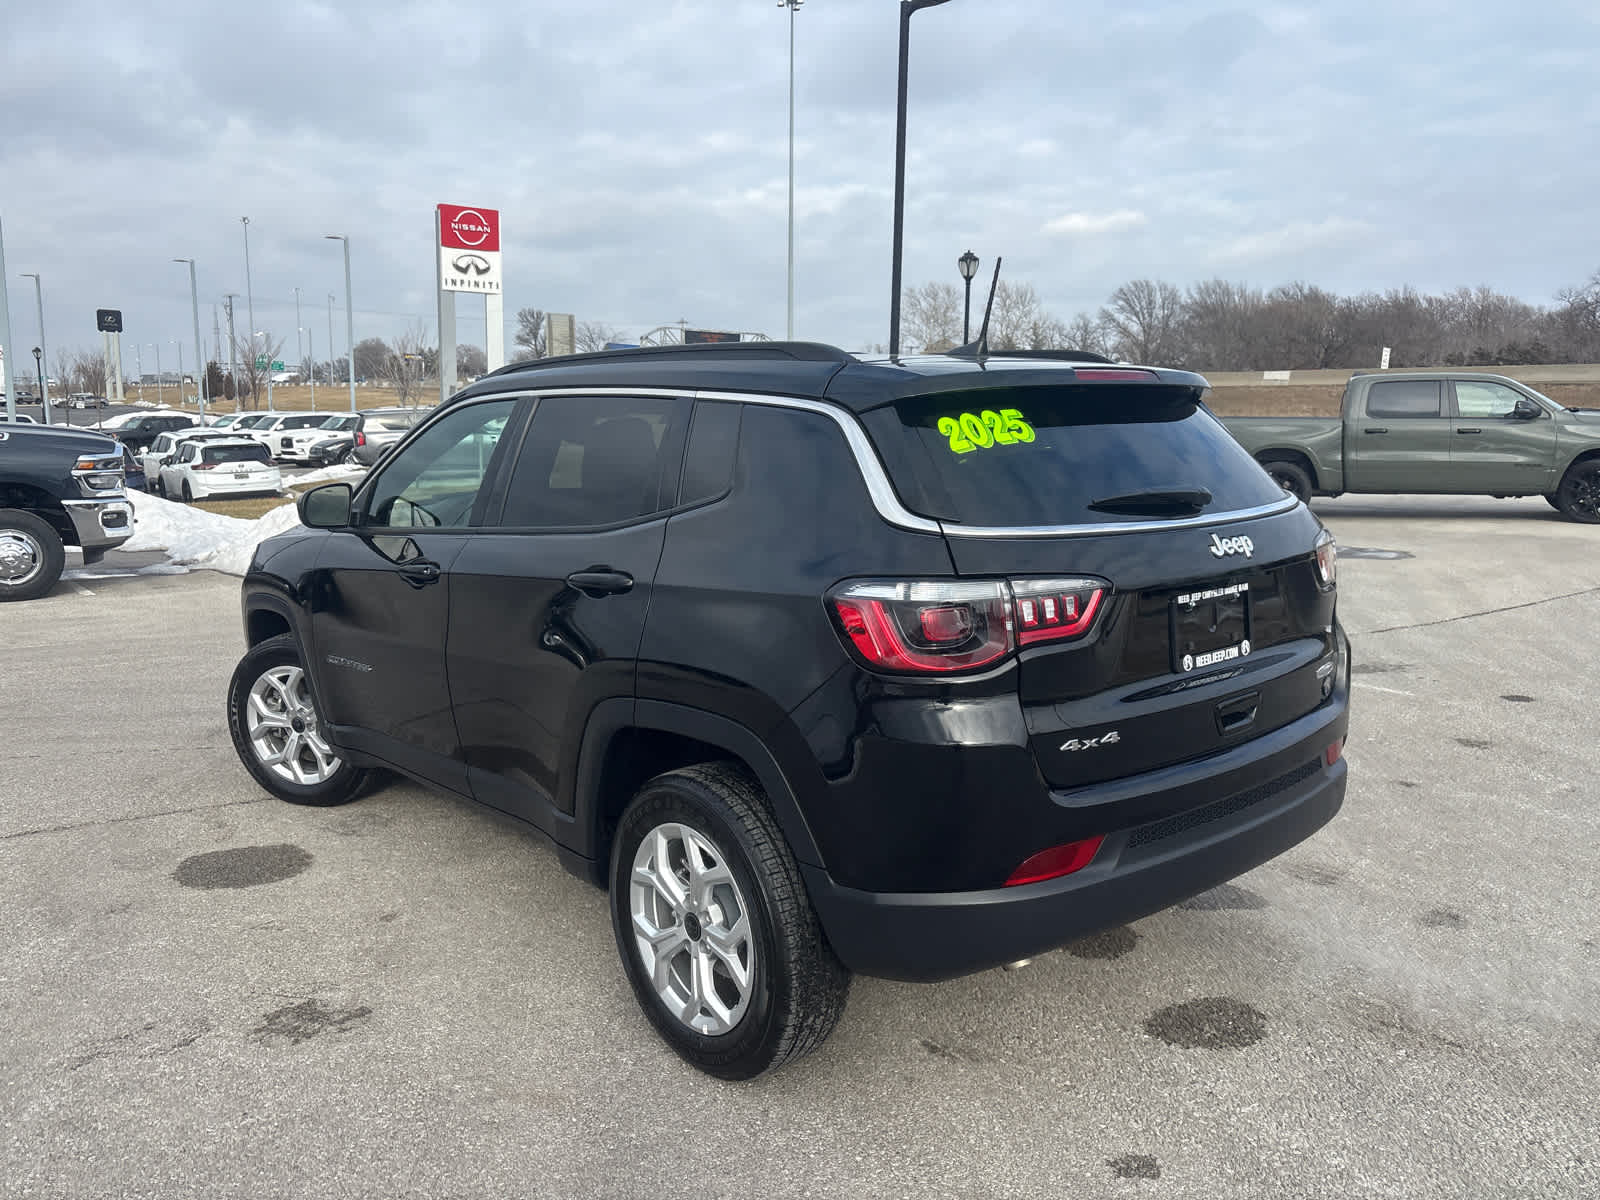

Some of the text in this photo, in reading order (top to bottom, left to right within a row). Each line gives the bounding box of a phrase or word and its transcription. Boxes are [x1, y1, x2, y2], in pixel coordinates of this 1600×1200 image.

[451, 222, 490, 232] NISSAN
[444, 279, 499, 289] INFINITI
[937, 408, 1035, 454] 2025
[1210, 533, 1254, 558] Jeep
[1191, 592, 1202, 601] JEEP
